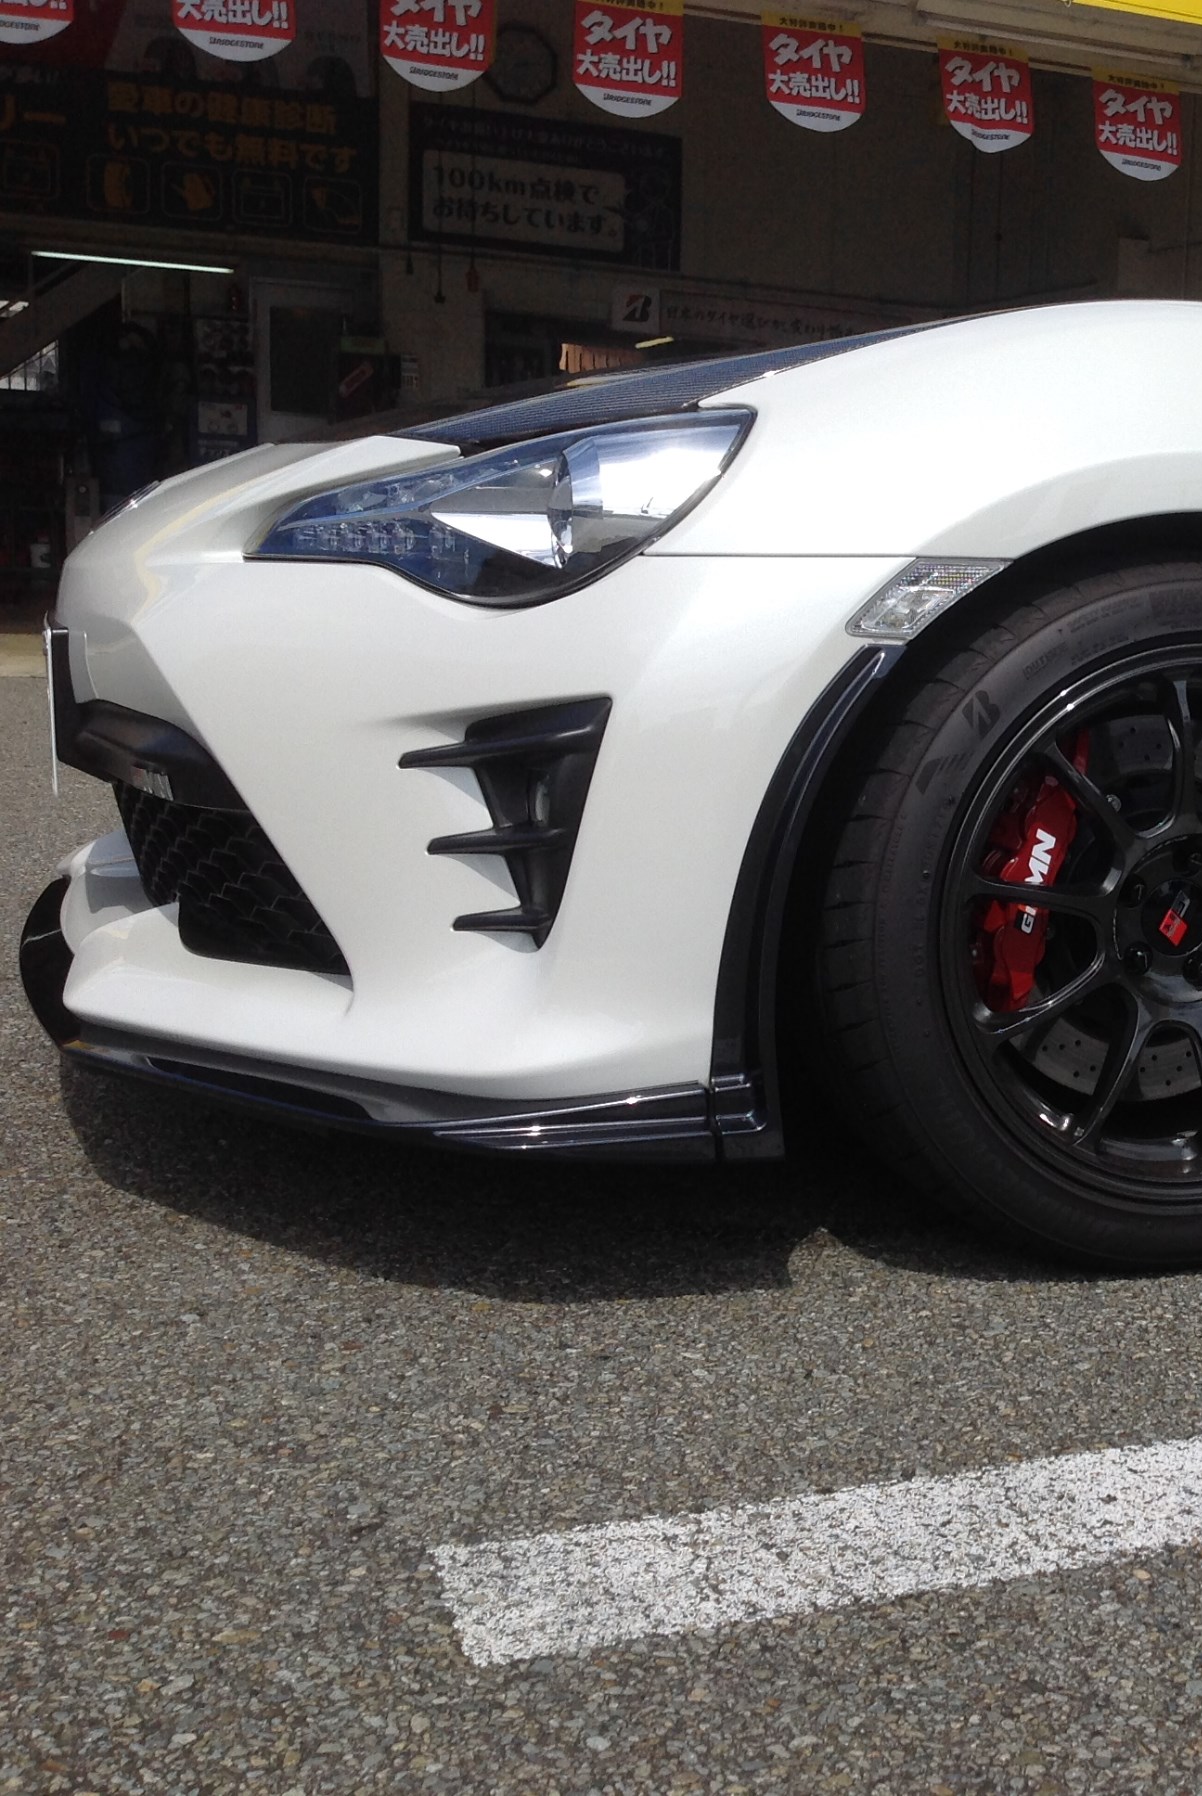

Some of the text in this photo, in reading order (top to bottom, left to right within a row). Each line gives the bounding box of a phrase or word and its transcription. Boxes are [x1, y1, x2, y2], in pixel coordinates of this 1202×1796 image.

[383, 20, 485, 60] 大売出し!!
[581, 10, 672, 53] タイヤ
[576, 49, 676, 87] 大売出し!!
[768, 33, 853, 72] タイヤ
[768, 69, 860, 104] 大売出し!!
[945, 56, 1021, 93] タイヤ
[946, 90, 1028, 125] 大売出し!!
[1099, 89, 1173, 125] タイヤ
[107, 123, 357, 173] いつでも無料です
[1098, 120, 1177, 155] 大売出し!!
